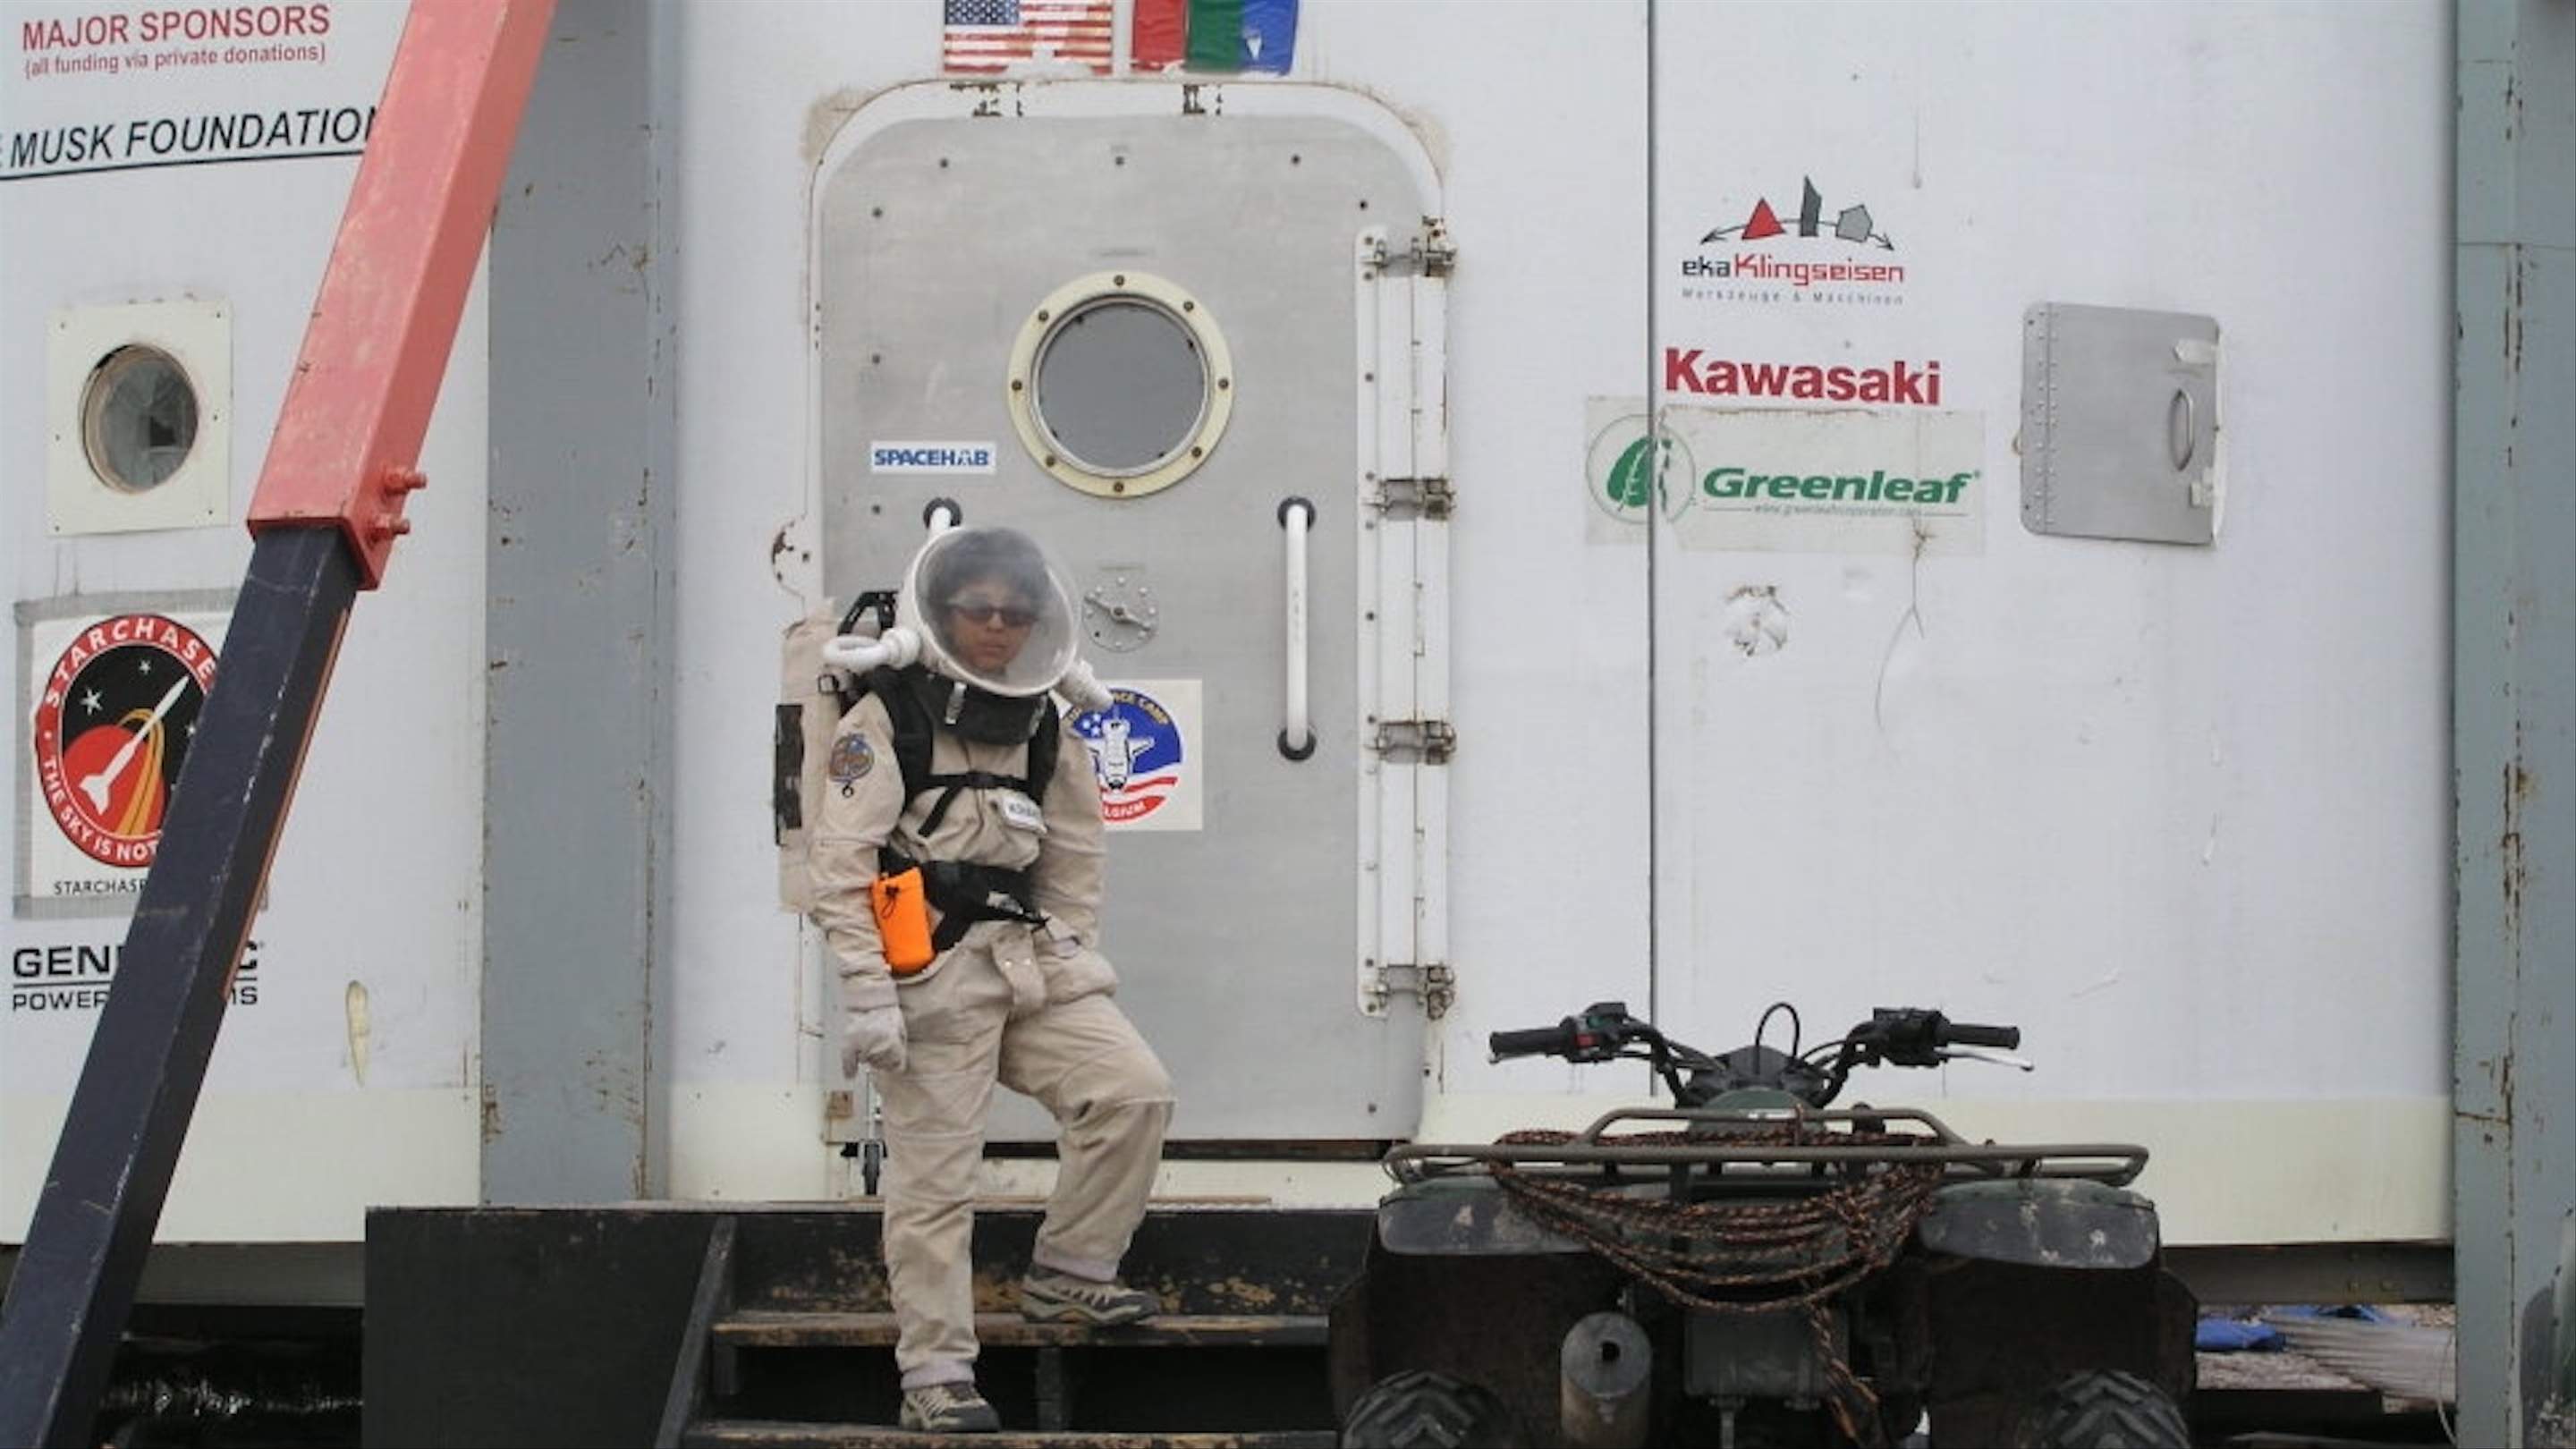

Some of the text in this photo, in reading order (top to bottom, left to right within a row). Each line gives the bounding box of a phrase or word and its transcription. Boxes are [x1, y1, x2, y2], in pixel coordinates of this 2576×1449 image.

[23, 4, 330, 51] MAJOR SPONSORS
[25, 43, 326, 80] (all funding via private donations)
[11, 123, 115, 168] MUSK
[1665, 346, 1941, 407] Kawasaki
[1703, 467, 1973, 504] Greenleaf
[47, 617, 216, 708] STARCHASE
[44, 758, 66, 805] THE
[61, 805, 94, 842] SKY
[93, 836, 112, 856] IS
